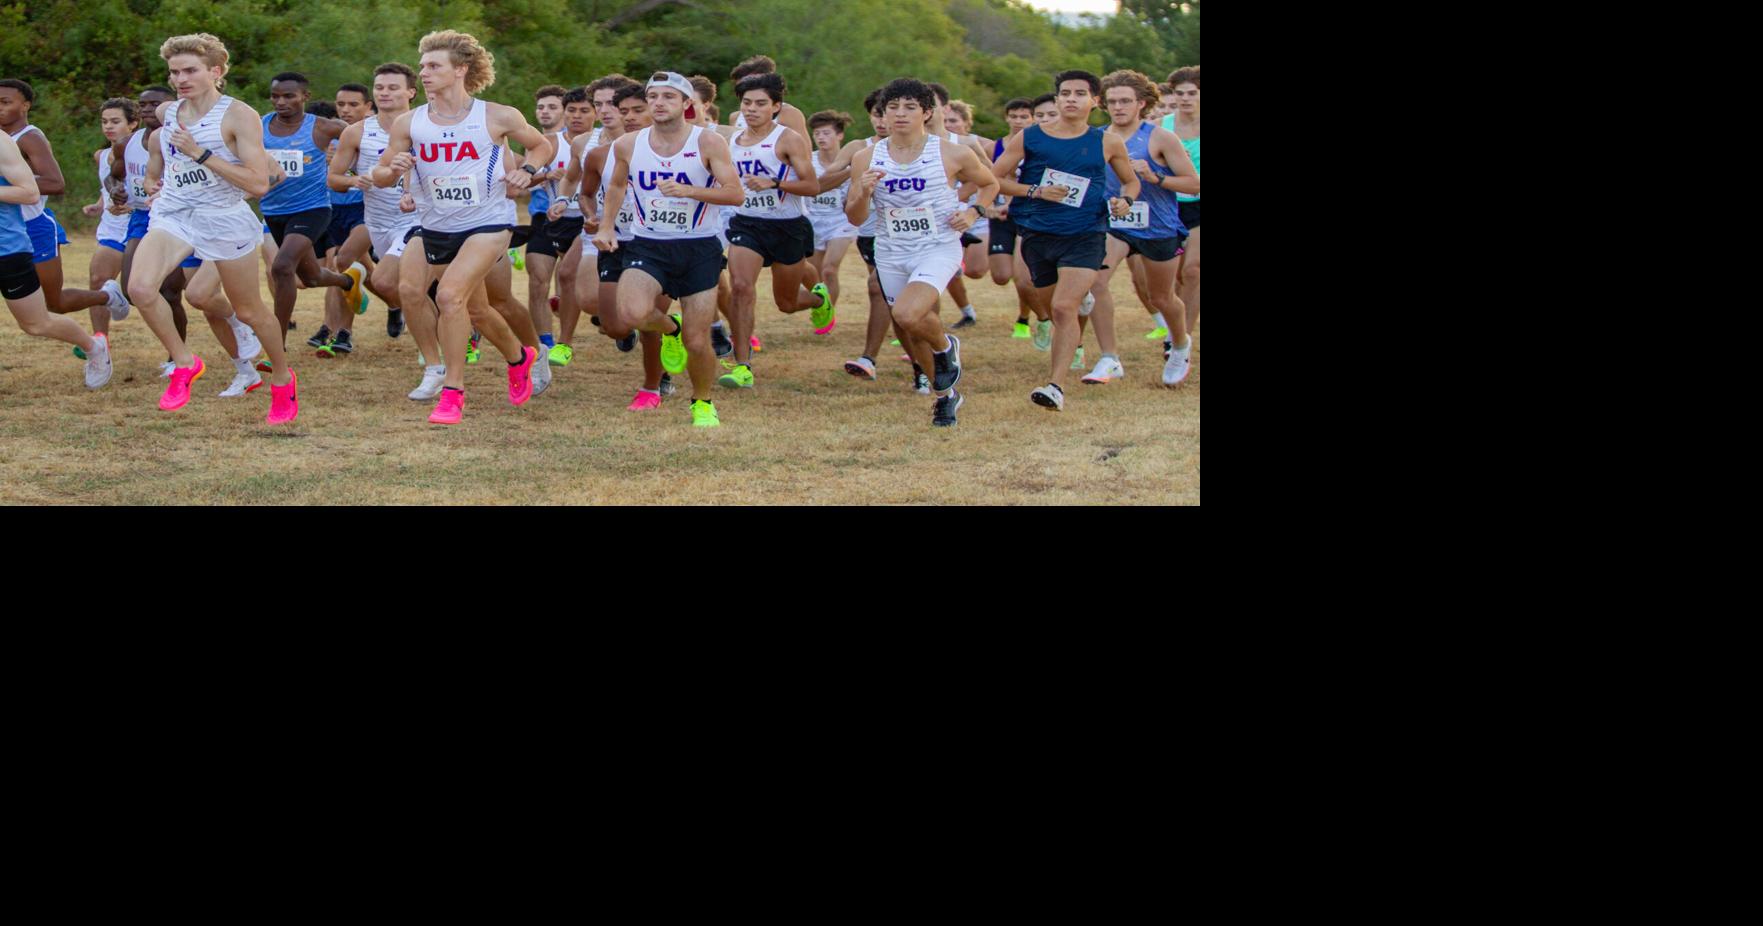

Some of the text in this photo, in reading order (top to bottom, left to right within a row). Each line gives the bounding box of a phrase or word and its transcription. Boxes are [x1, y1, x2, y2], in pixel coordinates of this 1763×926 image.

[420, 141, 480, 163] UTA
[174, 168, 208, 188] 3400
[638, 170, 693, 191] UTA
[884, 177, 927, 194] TCU
[435, 187, 472, 201] 3420
[744, 195, 775, 208] 3418
[650, 209, 687, 224] 3426
[892, 218, 930, 233] 3398
